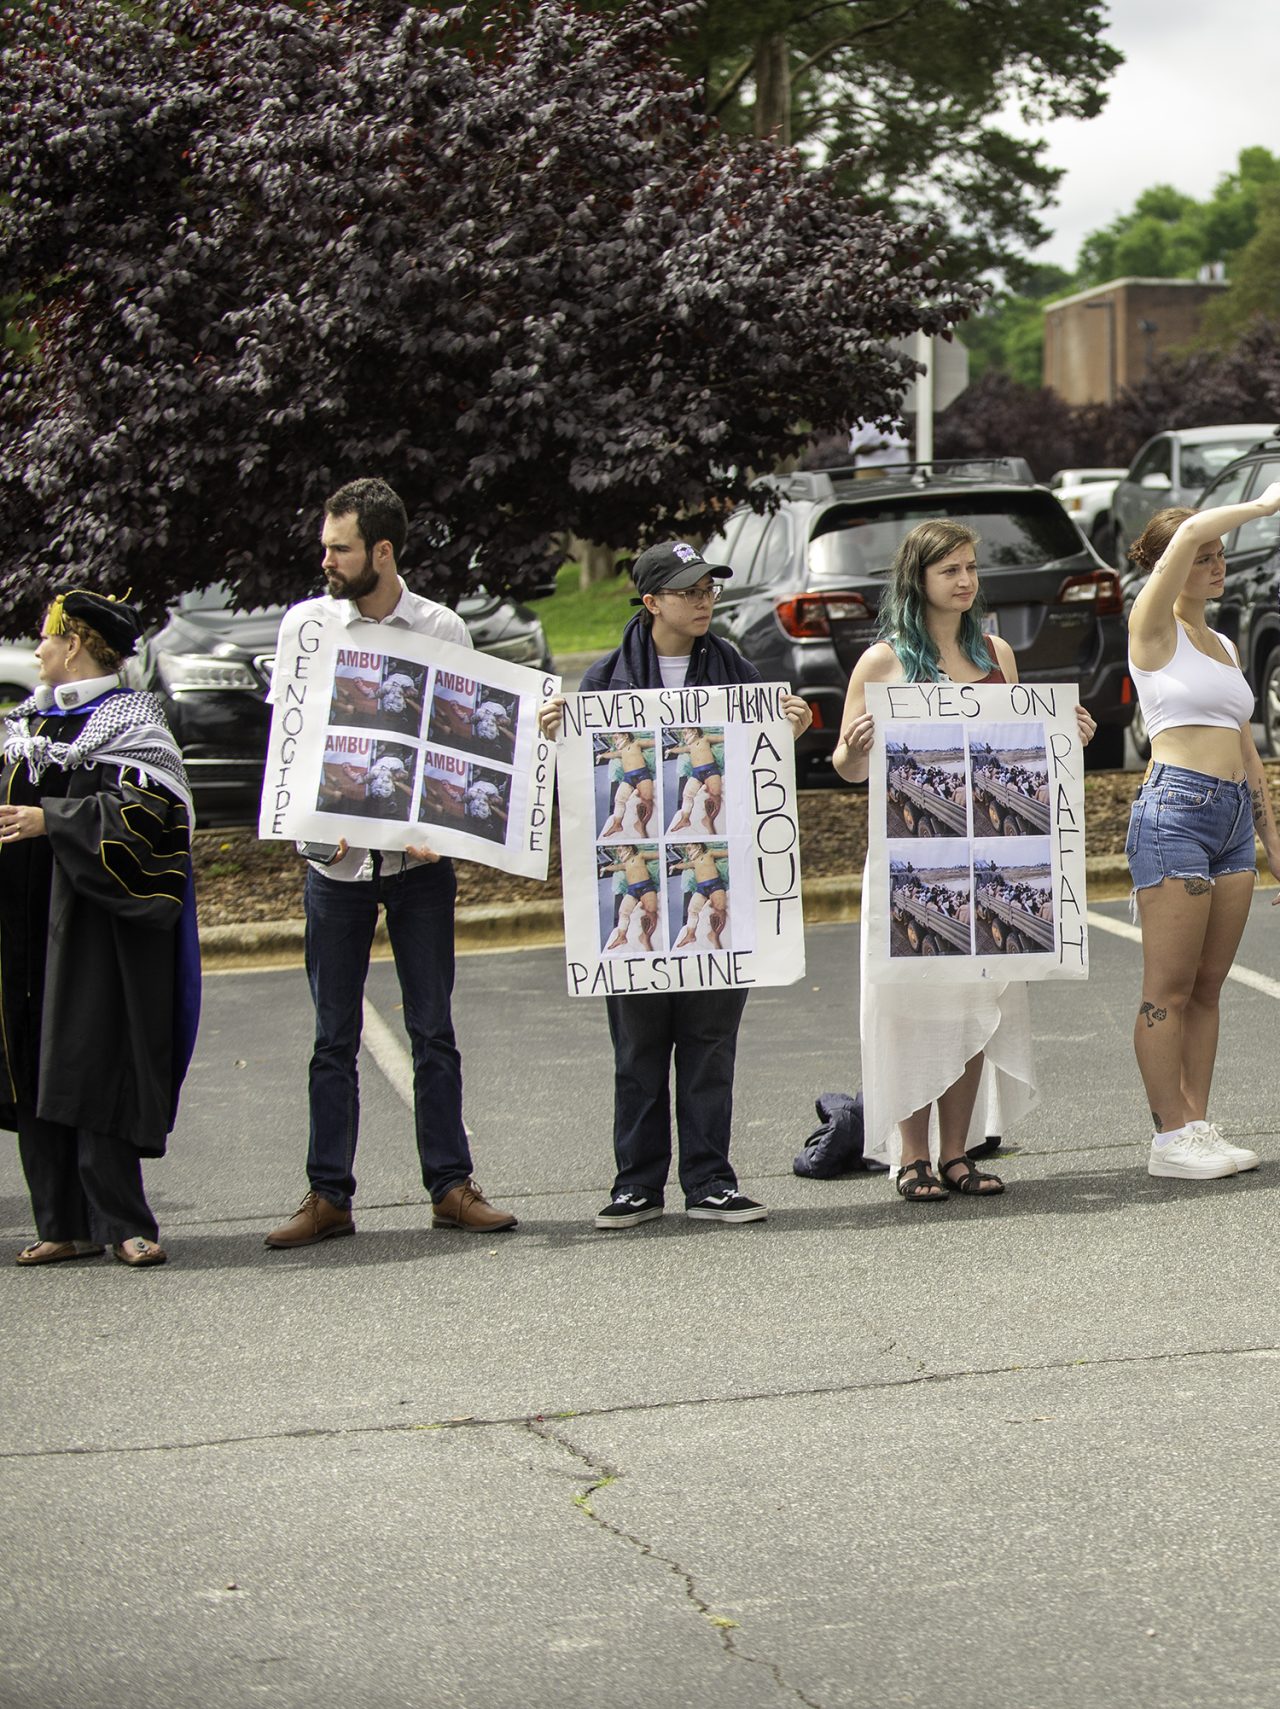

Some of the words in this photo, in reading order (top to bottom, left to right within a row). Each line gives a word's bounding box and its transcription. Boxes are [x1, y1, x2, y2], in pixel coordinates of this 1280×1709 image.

[337, 649, 381, 671] AMBU
[435, 669, 475, 697] AMBU
[887, 686, 980, 718] EYES
[1010, 685, 1056, 717] ON
[561, 692, 646, 738] NEVER
[660, 689, 709, 726] STOP
[325, 735, 369, 755] AMBU
[425, 750, 466, 776] AMBU
[530, 677, 554, 851] GOCIDE
[751, 732, 798, 935] ABOUT
[1050, 733, 1084, 965] RAFAH
[568, 951, 756, 994] PALESTINE
